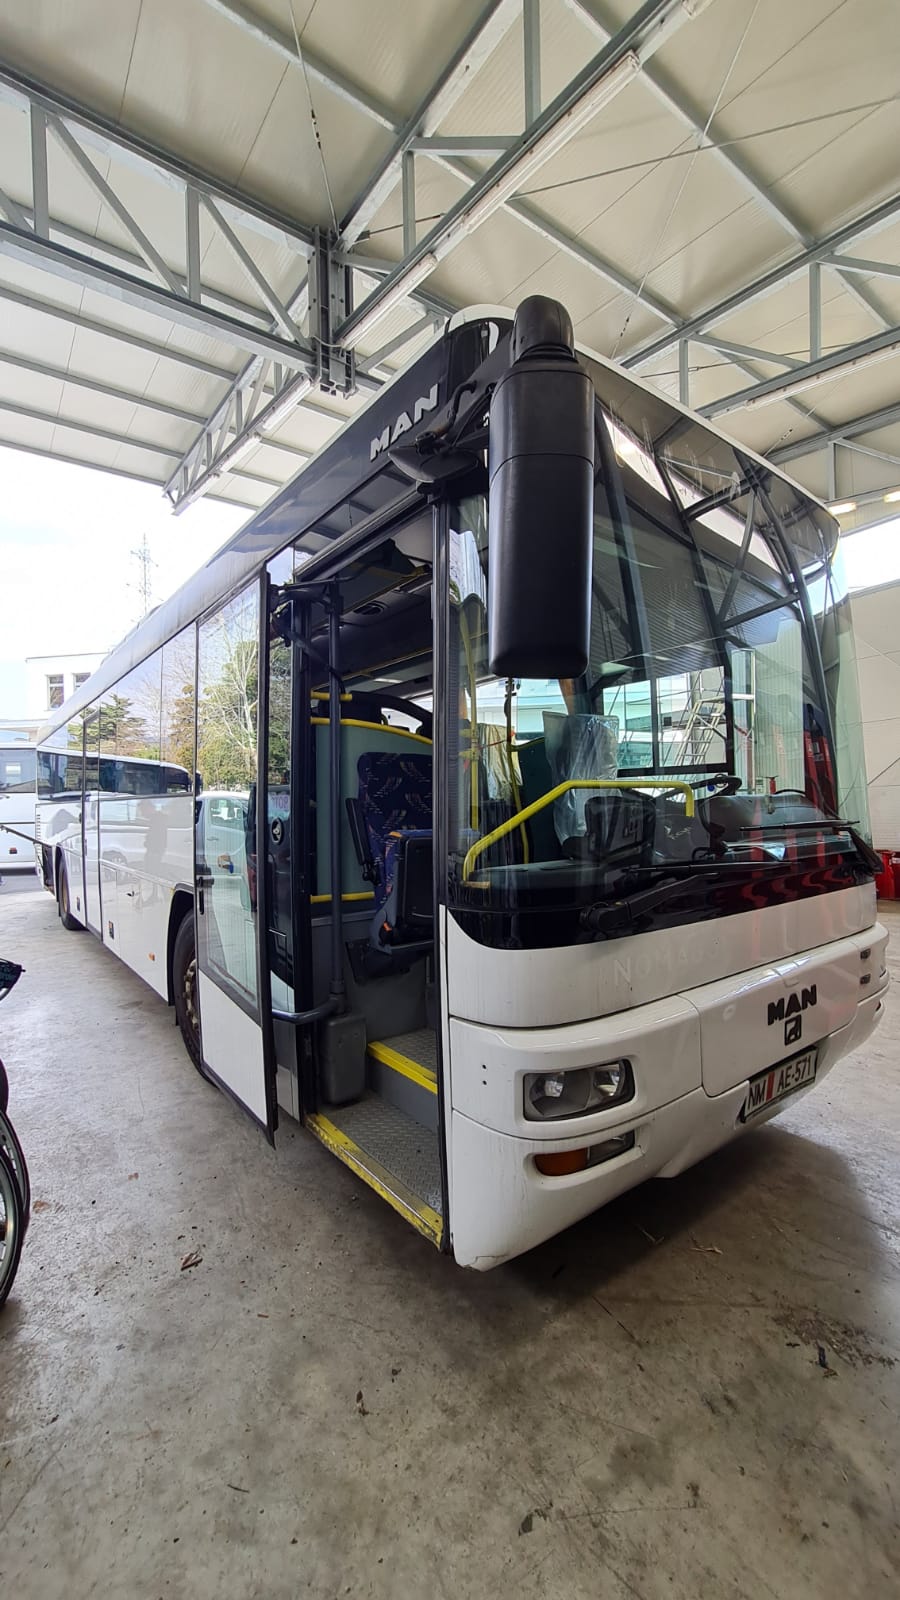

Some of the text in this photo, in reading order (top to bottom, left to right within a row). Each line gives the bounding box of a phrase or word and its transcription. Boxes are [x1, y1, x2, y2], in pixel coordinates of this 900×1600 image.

[370, 384, 438, 461] MAN
[768, 985, 817, 1026] MAN
[748, 1056, 811, 1110] NM AE-571
